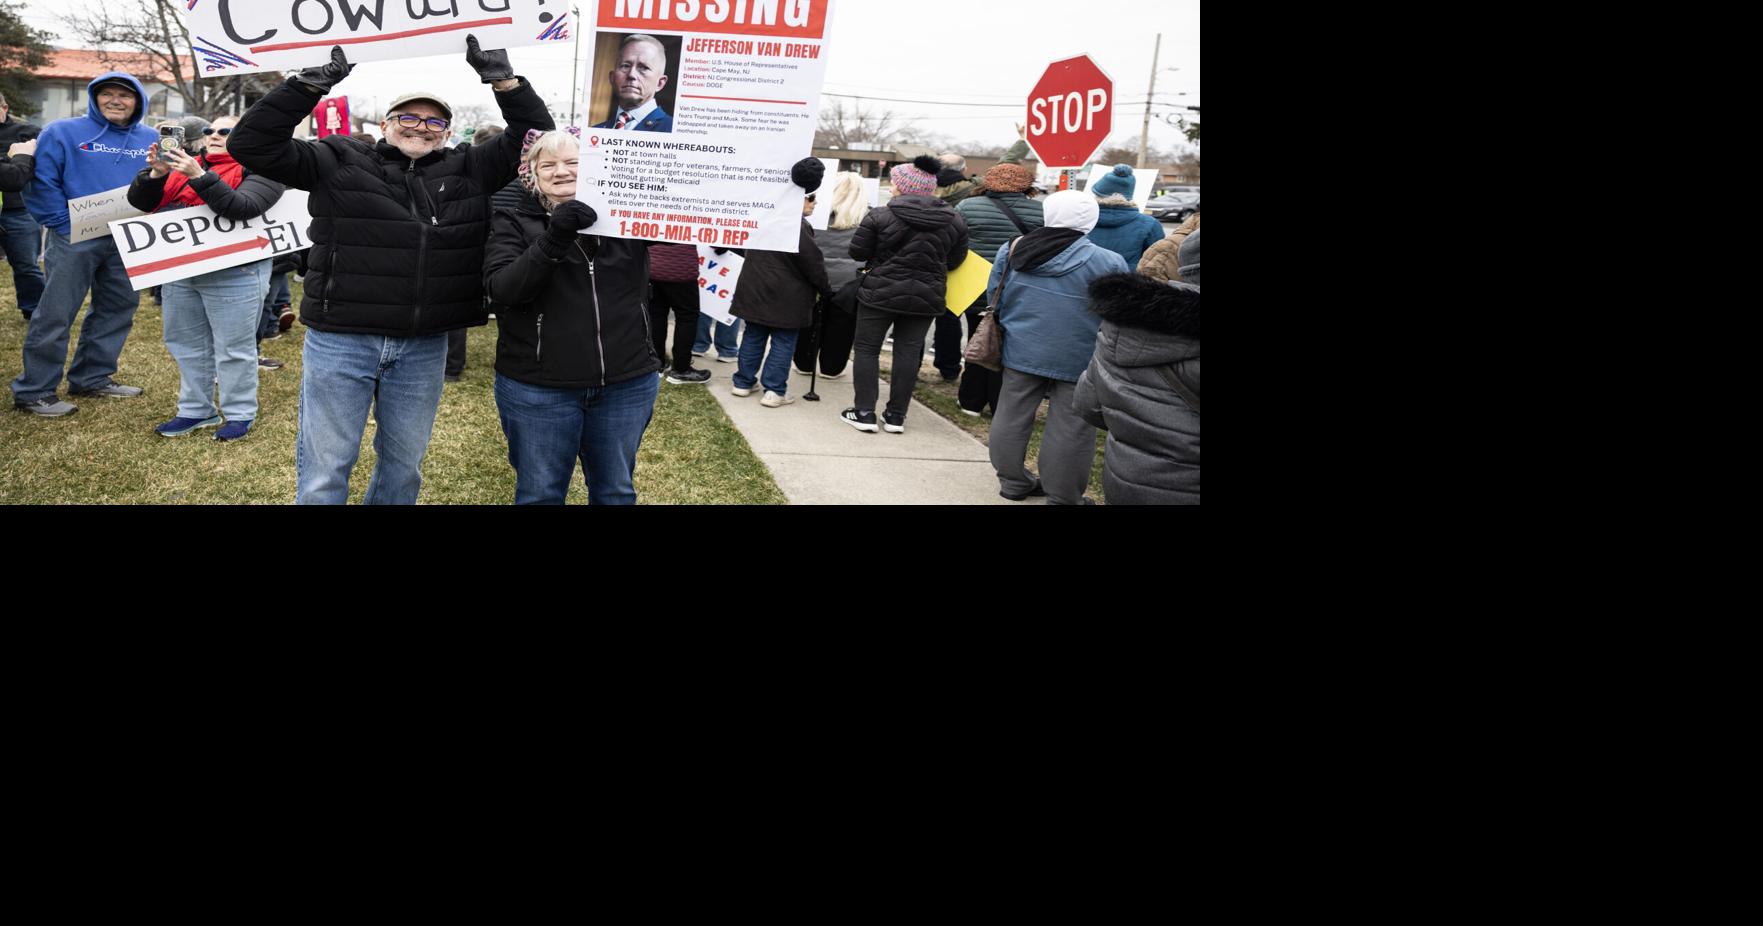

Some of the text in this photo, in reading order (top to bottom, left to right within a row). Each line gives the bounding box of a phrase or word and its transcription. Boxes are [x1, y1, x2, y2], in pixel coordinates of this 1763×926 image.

[217, 0, 554, 45] Cowa
[686, 38, 821, 59] JEFFERSON VAN DREW
[751, 62, 798, 70] Representatives
[716, 75, 757, 83] Congressional
[1030, 88, 1107, 136] STOP
[602, 138, 736, 154] LAST KNOWN WHEREABOUTS:
[630, 158, 661, 168] standing
[686, 162, 720, 172] veterans,
[722, 164, 752, 174] farmers,
[611, 165, 634, 174] Voting
[654, 168, 680, 177] budget
[682, 170, 719, 179] resolution
[760, 176, 789, 184] feasible
[640, 176, 665, 184] gutting
[667, 176, 700, 186] Medicaid
[608, 181, 626, 189] YOU
[647, 184, 668, 192] HIM:
[72, 198, 114, 213] When
[650, 193, 670, 201] backs
[672, 196, 710, 204] extremists
[618, 210, 632, 218] YOU
[633, 211, 650, 220] HAVE
[652, 212, 665, 221] ANY
[666, 213, 714, 226] INFORMATION,
[716, 218, 740, 228] PLEASE
[742, 220, 758, 229] CALL
[722, 207, 750, 216] district.
[263, 221, 312, 255] El
[620, 220, 750, 246] 1-800-MIA-(R) REP
